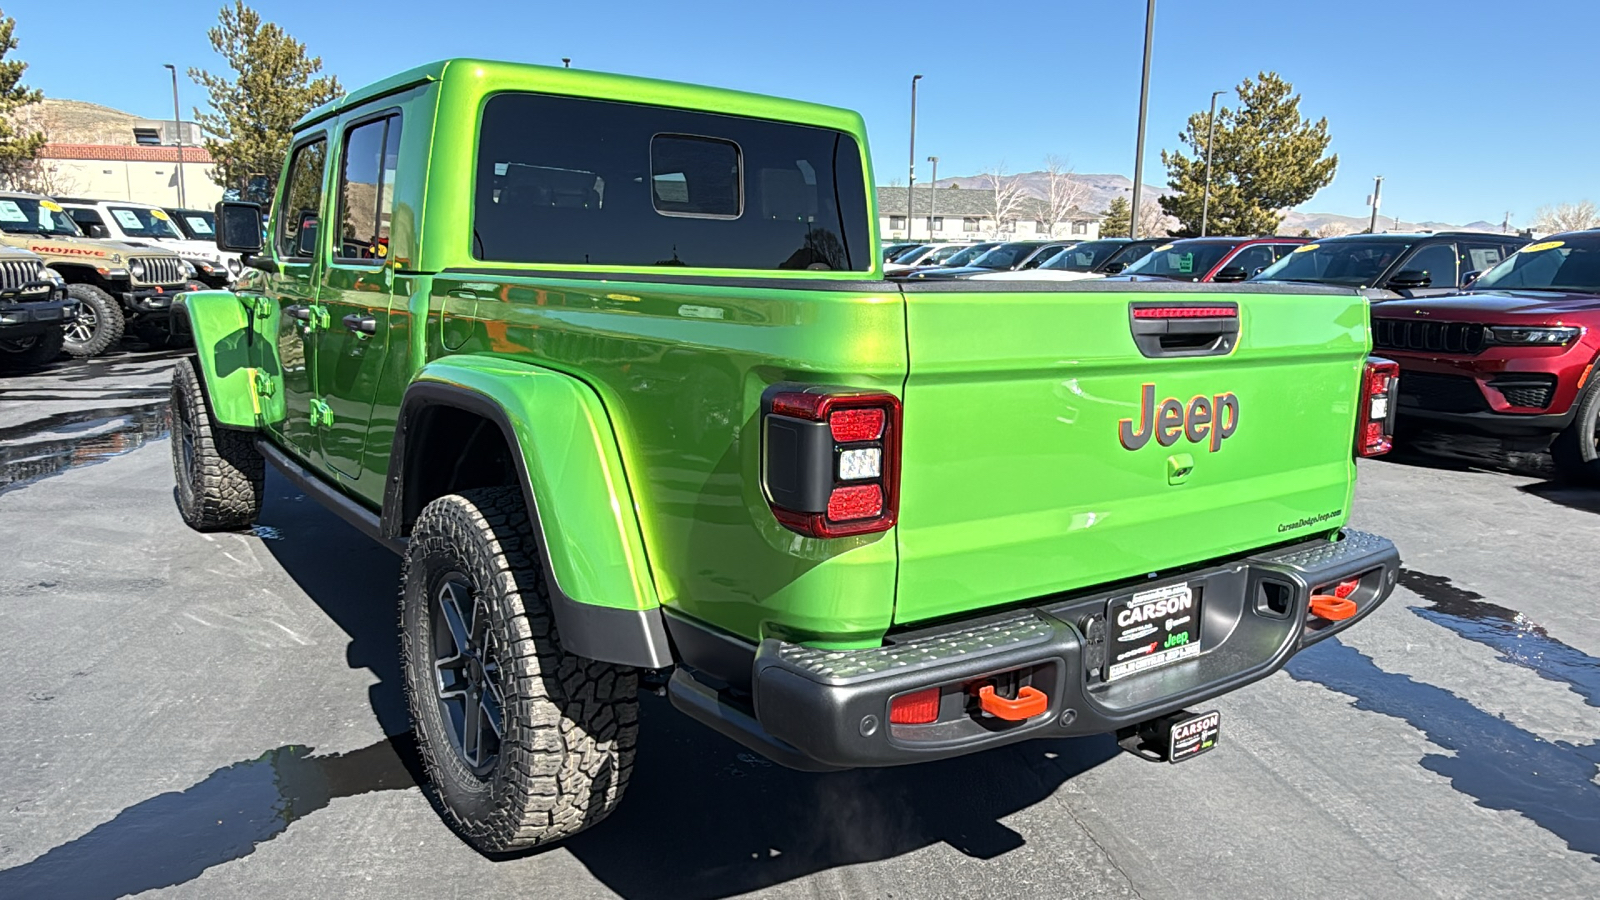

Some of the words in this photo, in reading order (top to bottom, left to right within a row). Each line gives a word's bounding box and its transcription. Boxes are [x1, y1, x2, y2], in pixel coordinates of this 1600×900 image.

[32, 246, 106, 257] MOJAVE
[1118, 382, 1239, 453] Jeep
[1117, 589, 1192, 627] CARSON
[1164, 631, 1188, 648] Jeep
[1174, 715, 1218, 740] CARSON
